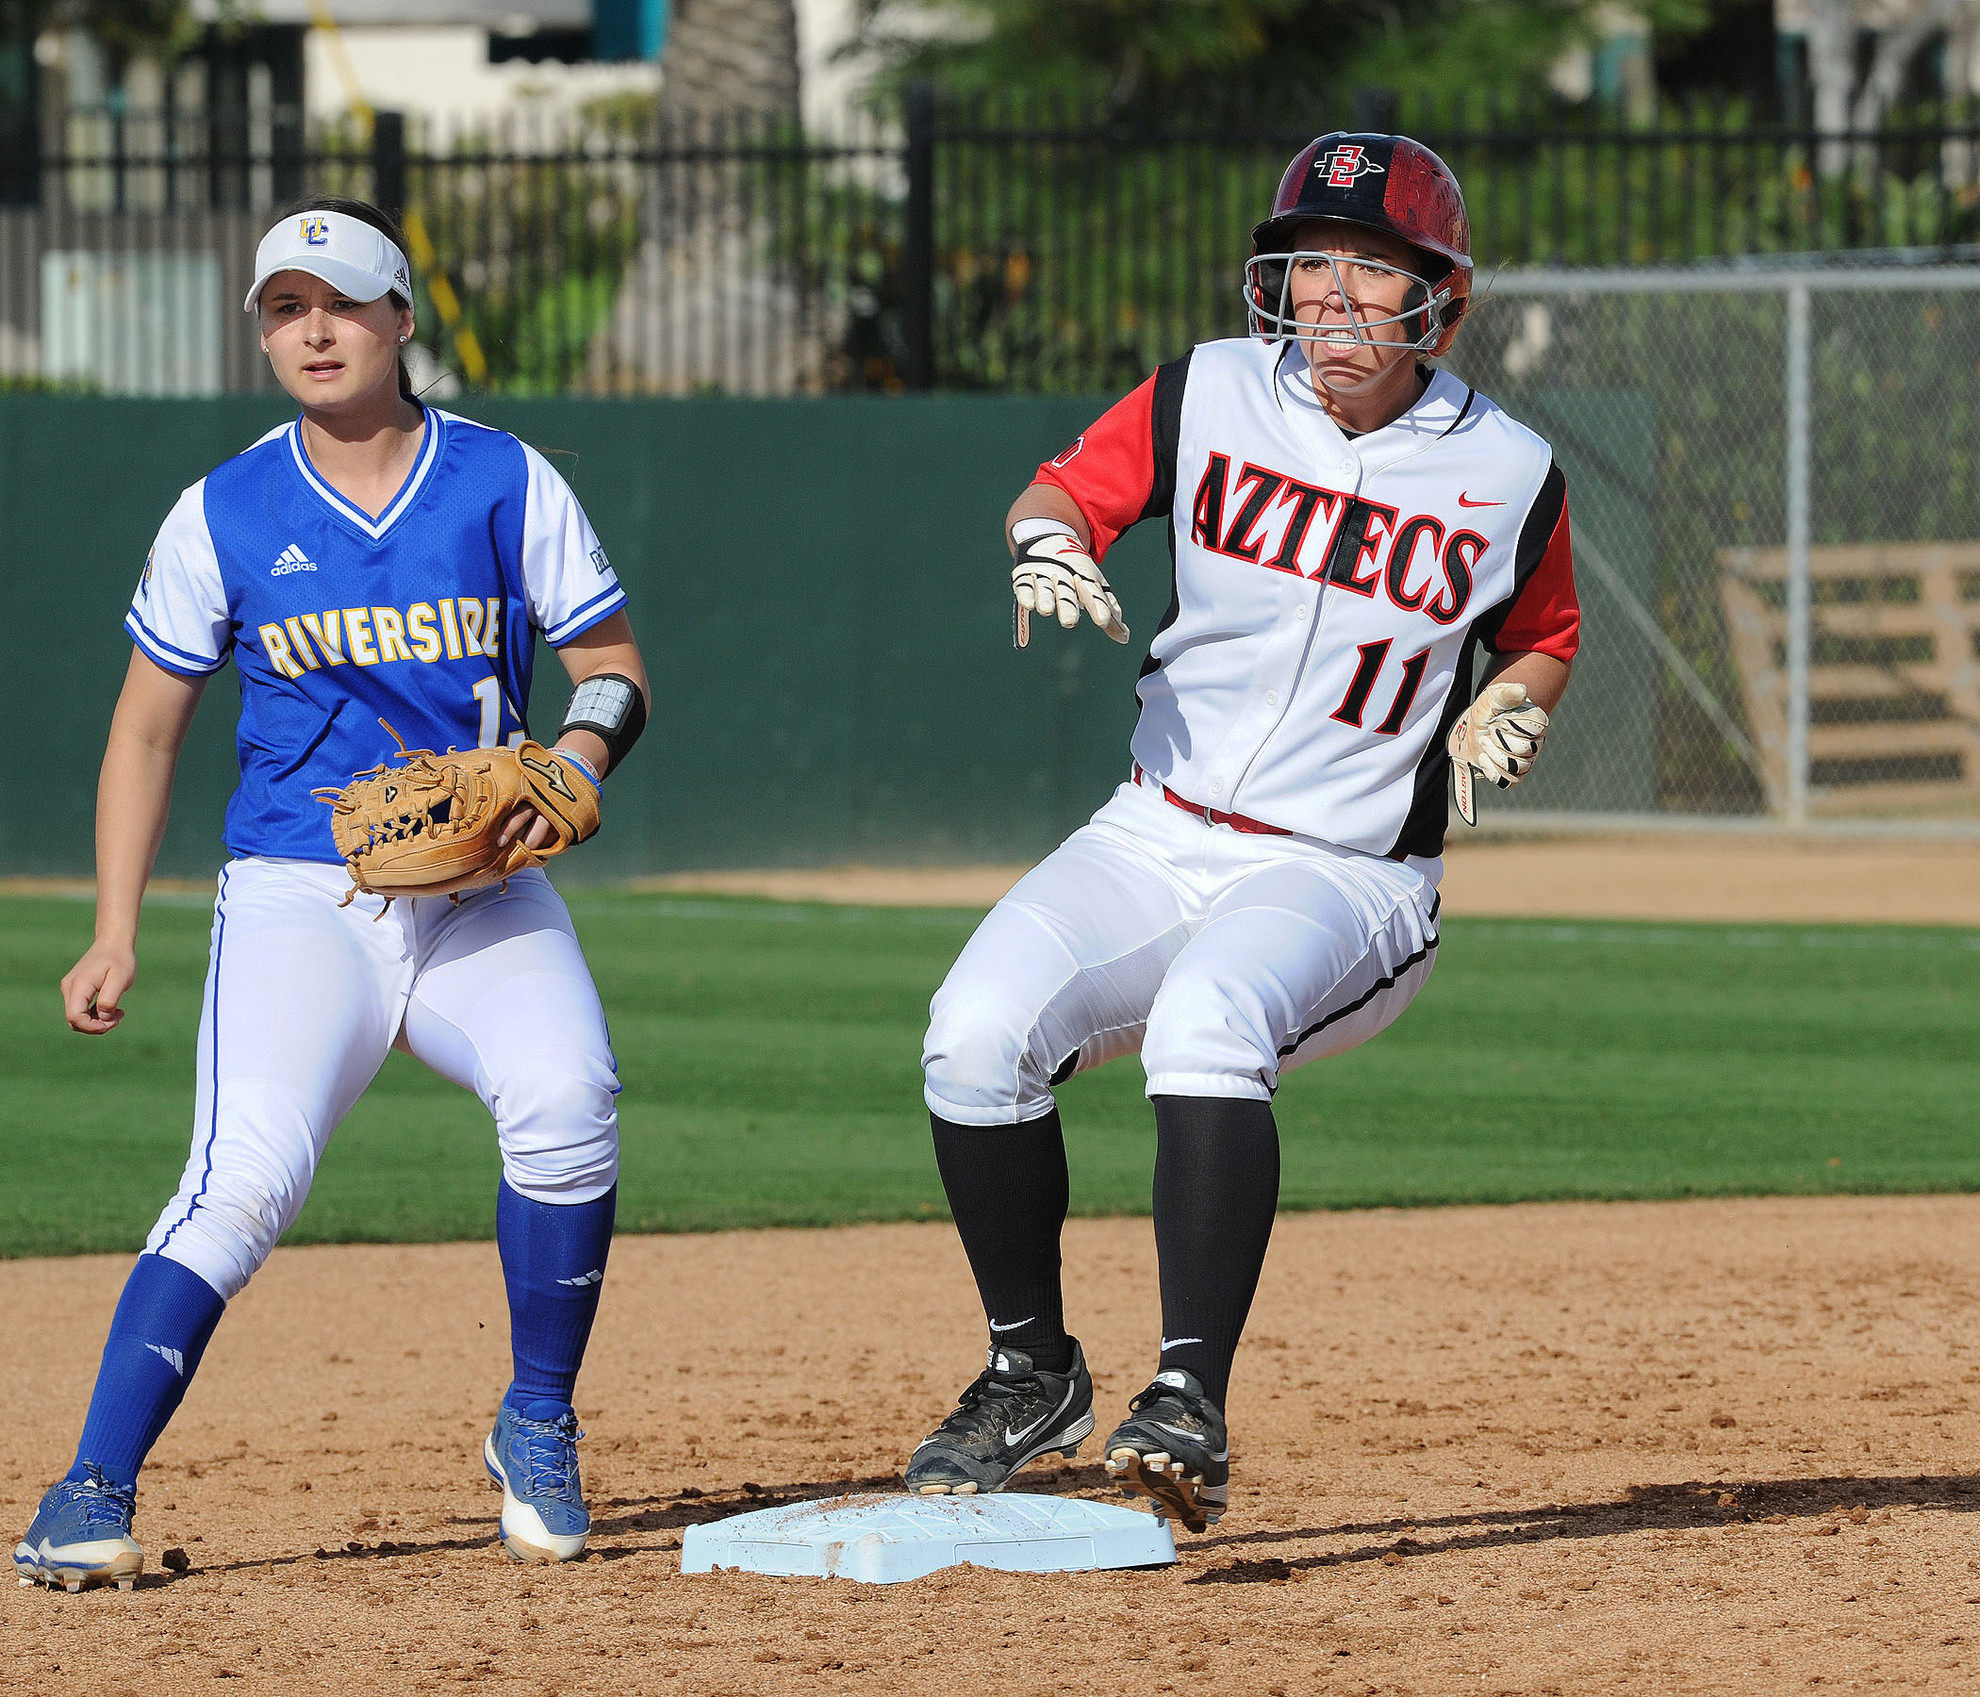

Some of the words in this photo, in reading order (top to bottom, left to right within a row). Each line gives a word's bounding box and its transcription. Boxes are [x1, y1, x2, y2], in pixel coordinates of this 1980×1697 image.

[300, 217, 329, 246] UC
[270, 561, 318, 577] adidas
[1191, 451, 1490, 625] AZTECS
[258, 597, 500, 679] RIVERSIDE
[1329, 637, 1431, 735] 11
